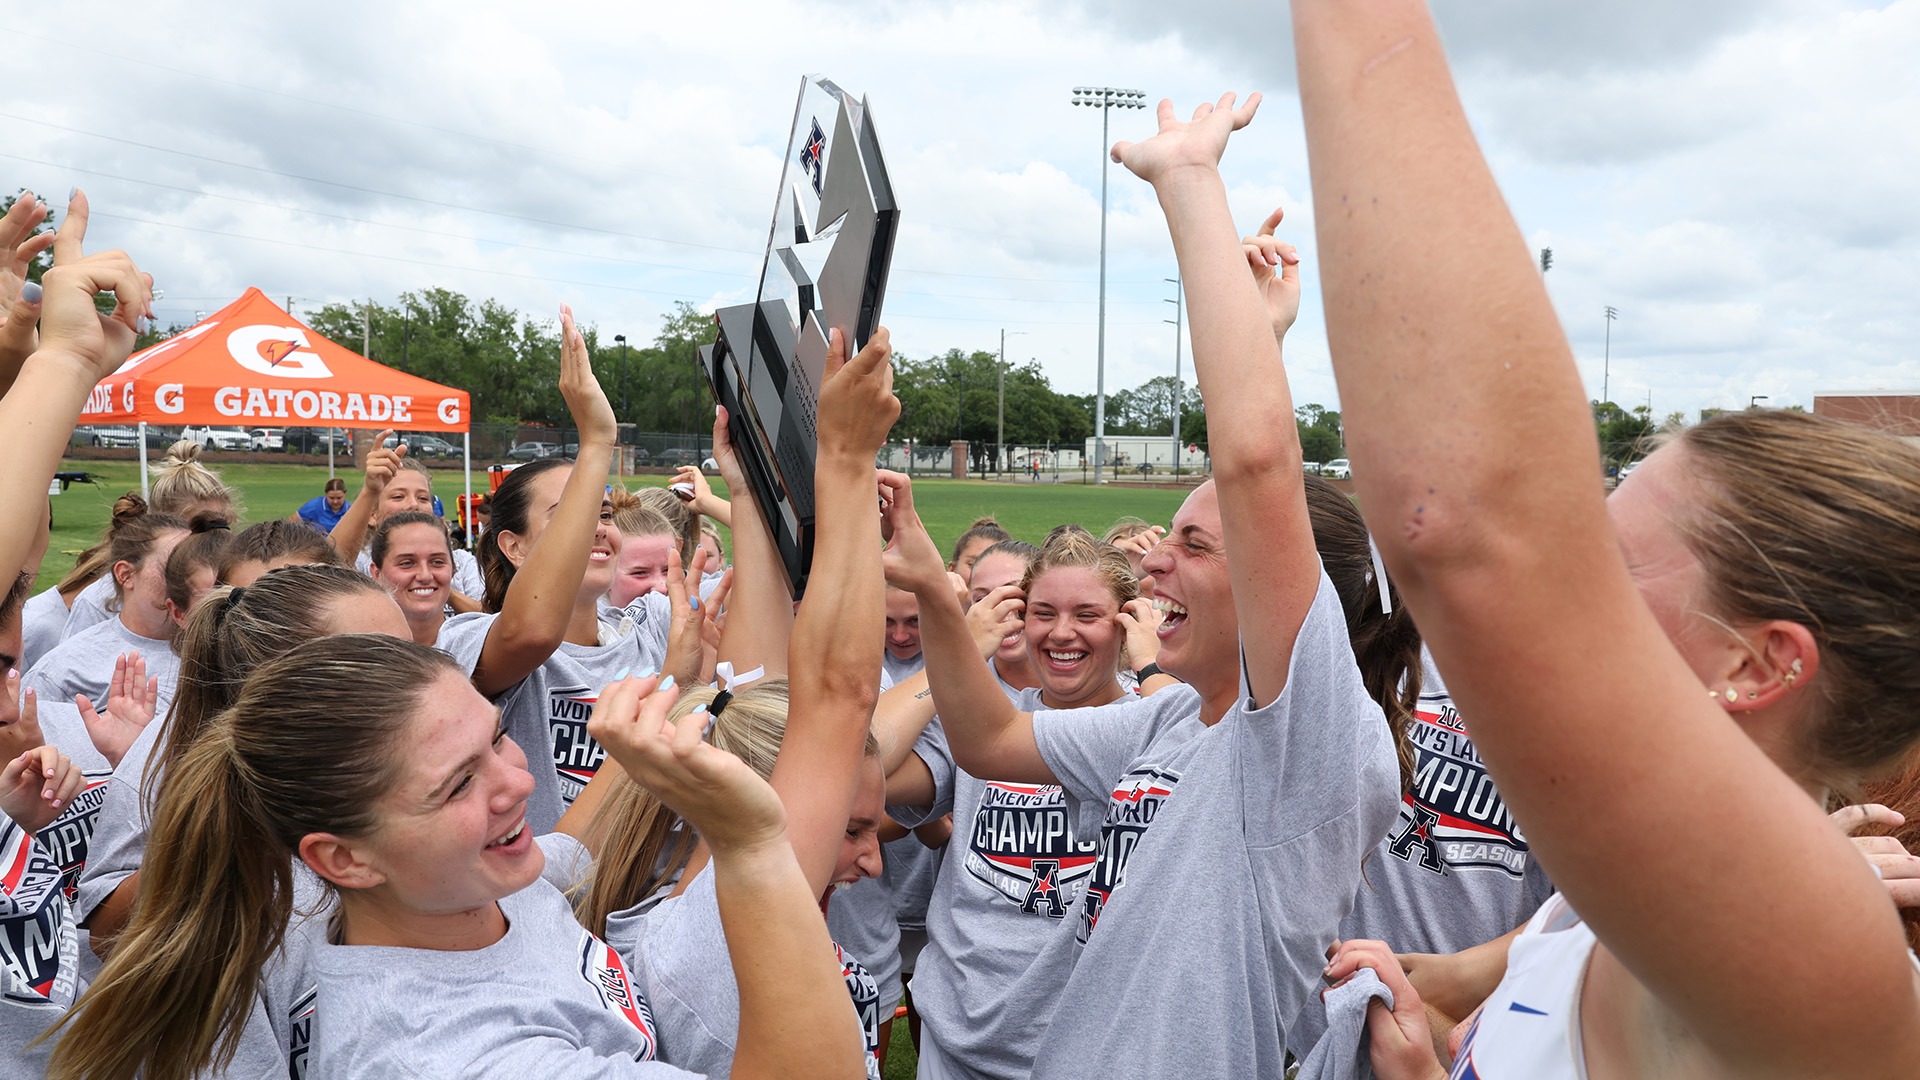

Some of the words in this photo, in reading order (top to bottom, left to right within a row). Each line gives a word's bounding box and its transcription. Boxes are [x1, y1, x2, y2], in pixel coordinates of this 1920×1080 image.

[226, 324, 334, 378] G
[81, 384, 113, 414] ADE
[123, 382, 134, 413] G
[154, 384, 184, 414] G
[214, 387, 412, 423] GATORADE
[437, 398, 460, 424] G
[1405, 722, 1449, 752] N'S
[1413, 753, 1527, 843] MPION
[36, 811, 100, 867] MPI
[1445, 843, 1527, 869] SEASON
[595, 966, 631, 1008] 2024
